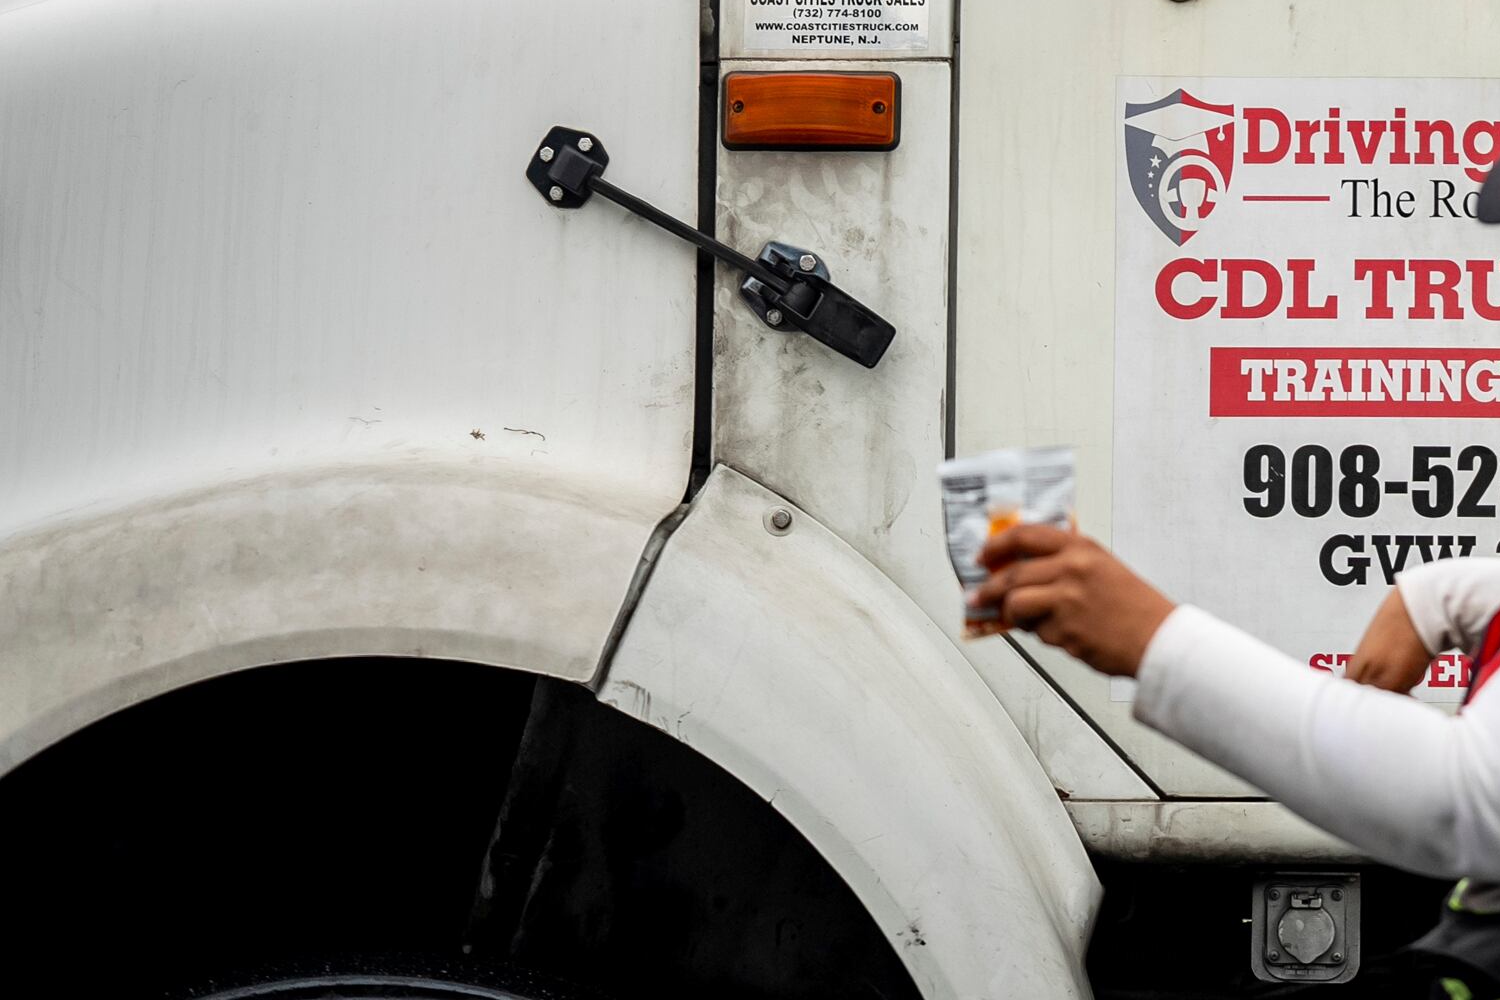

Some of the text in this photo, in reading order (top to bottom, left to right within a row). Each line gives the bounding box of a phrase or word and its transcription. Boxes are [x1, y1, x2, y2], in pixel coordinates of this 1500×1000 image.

[793, 8, 882, 19] (732) 774-8100
[755, 22, 919, 31] WWW.COASTCITIESTRUCK.COM
[792, 35, 881, 46] NEPTUNE, N.J.
[1341, 178, 1480, 218] The Ro
[1155, 257, 1338, 320] CDL
